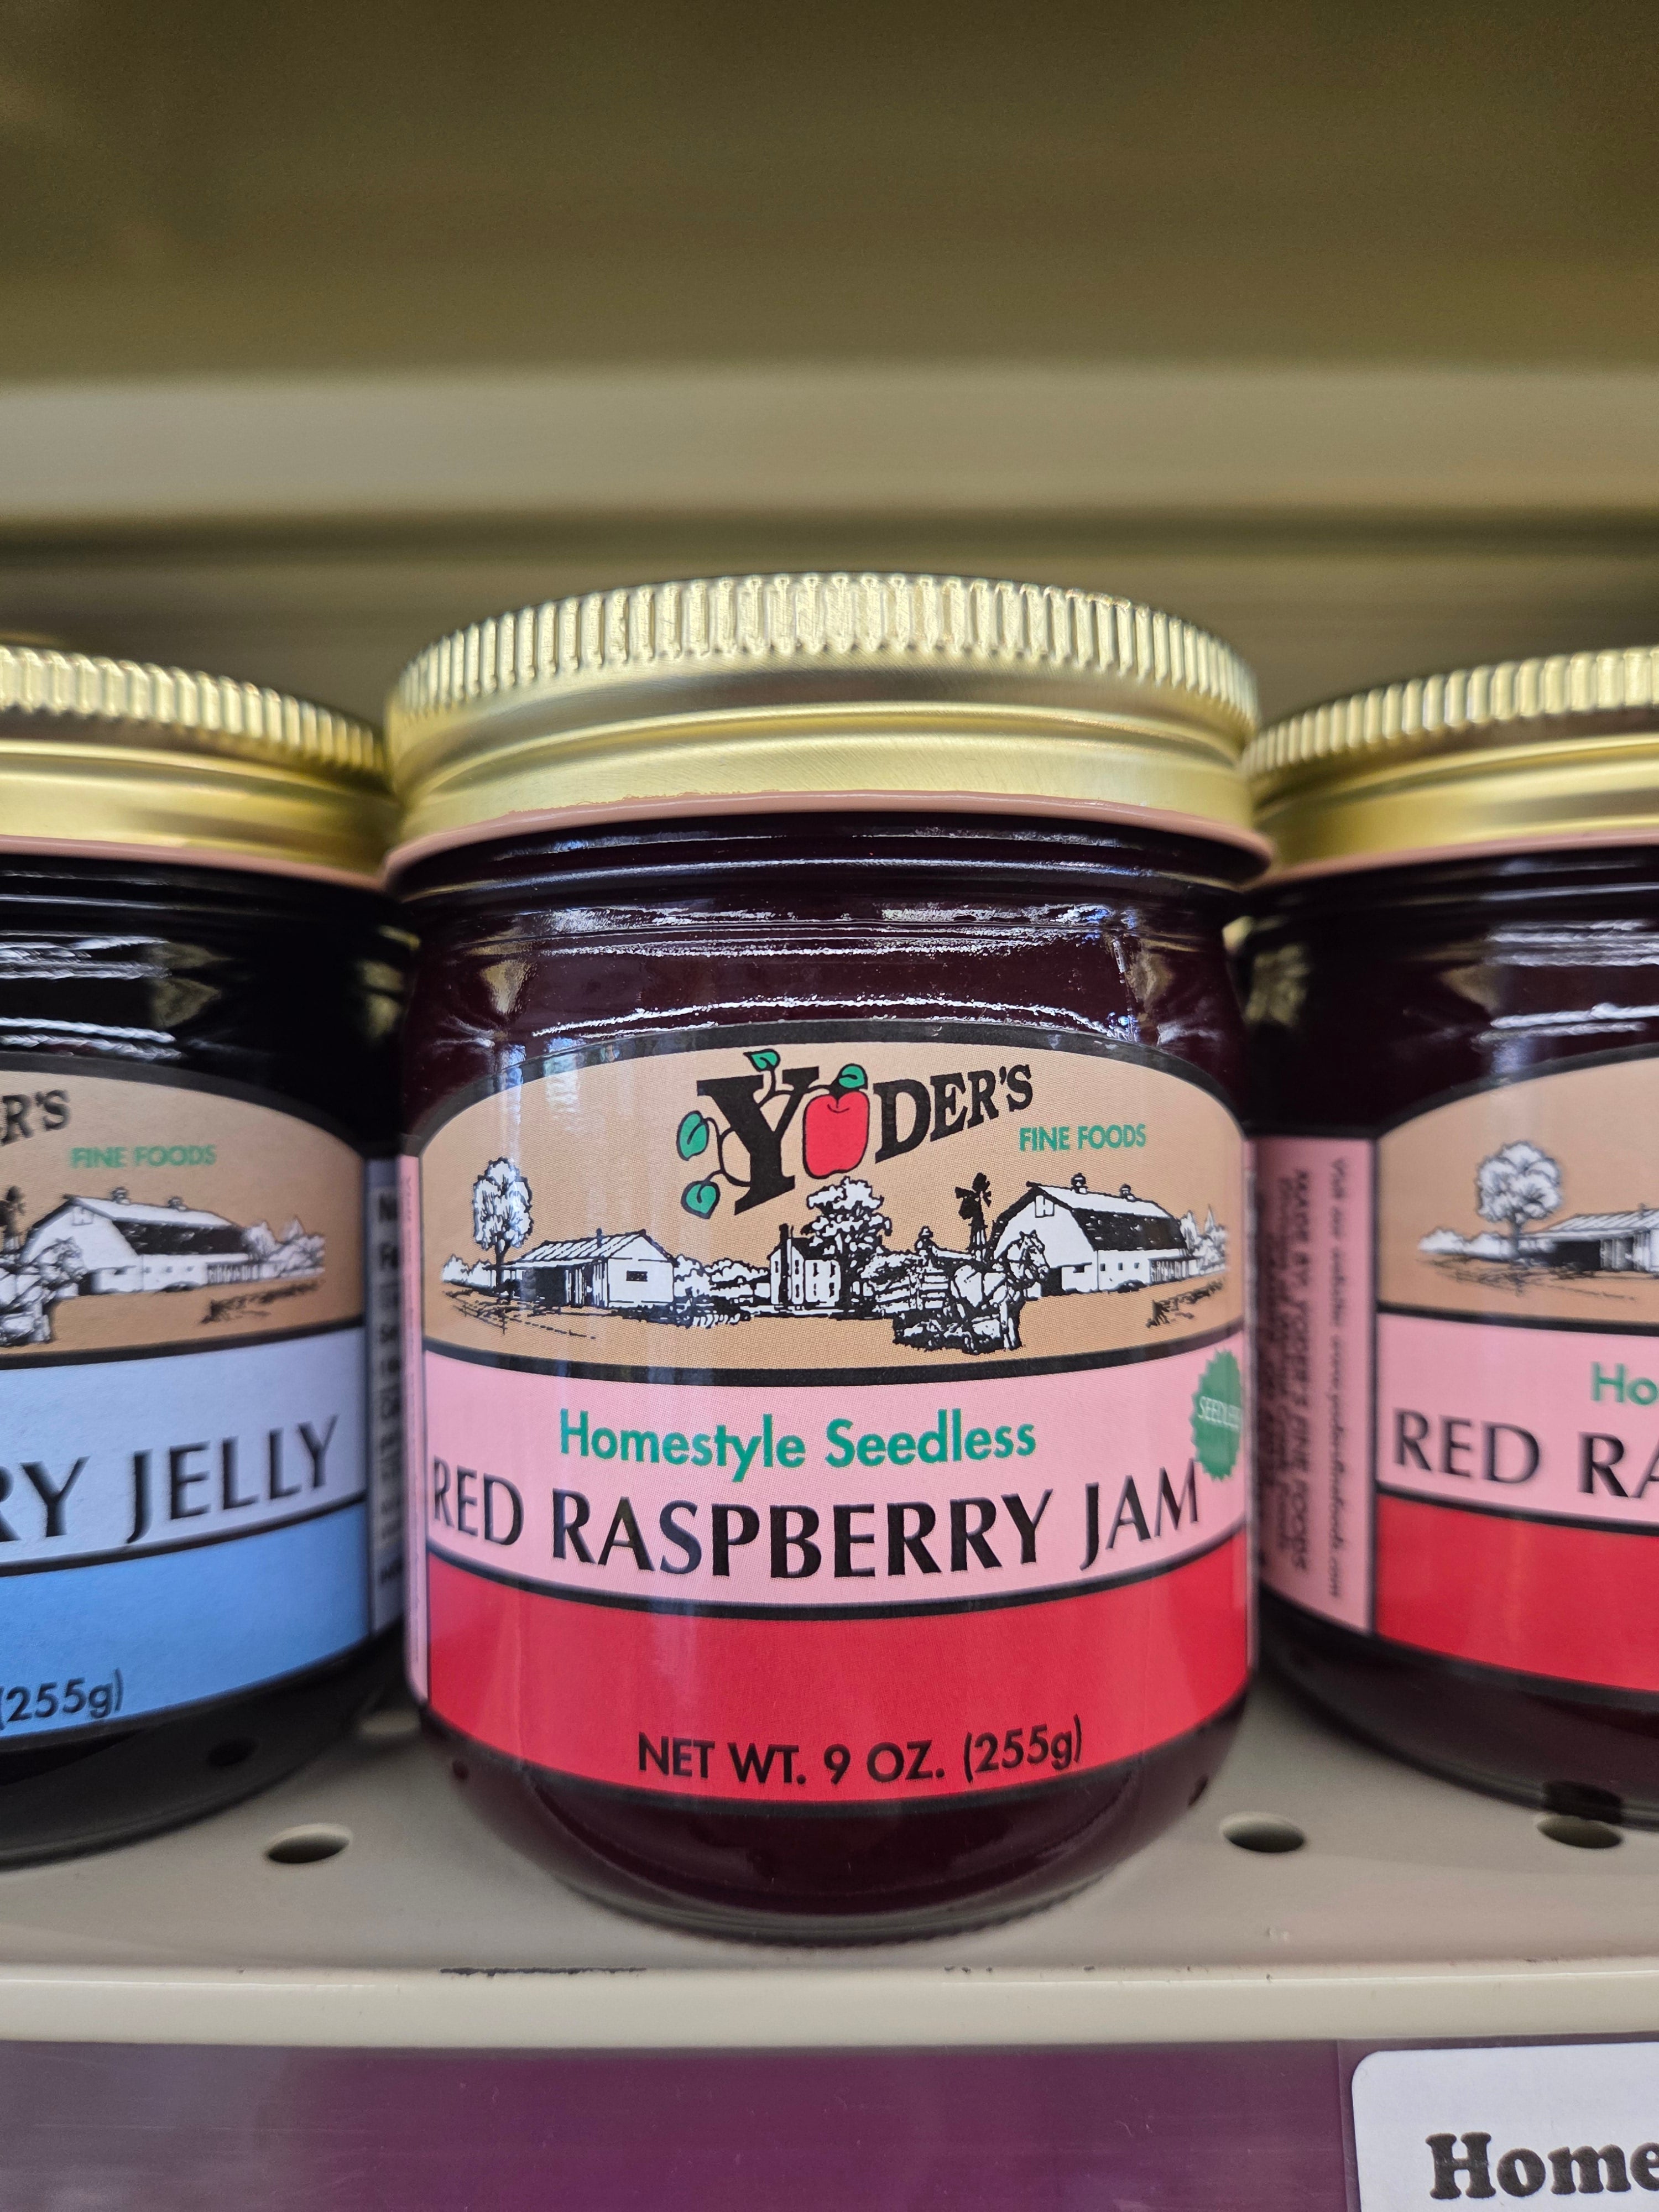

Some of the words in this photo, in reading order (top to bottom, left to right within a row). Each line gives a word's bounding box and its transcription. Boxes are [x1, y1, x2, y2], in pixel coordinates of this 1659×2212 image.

[69, 1146, 127, 1169] FINE
[133, 1144, 217, 1167] FOODS
[1020, 1127, 1070, 1151] FINE
[1077, 1123, 1147, 1149] FOODS
[1590, 1360, 1658, 1406] Ho
[126, 1414, 339, 1544] JELLY
[560, 1408, 806, 1483] Homestyle
[825, 1407, 1036, 1468] Seedless
[1392, 1407, 1540, 1484] RED
[433, 1455, 525, 1547] RED
[552, 1487, 1054, 1579] RASPBERRY
[1079, 1458, 1199, 1572] JAM
[638, 1731, 716, 1779] NET
[728, 1743, 806, 1785] WT.
[823, 1744, 851, 1785] 9
[866, 1740, 945, 1783] OZ.
[963, 1714, 1083, 1783] (255g)
[1425, 2131, 1659, 2199] Home
